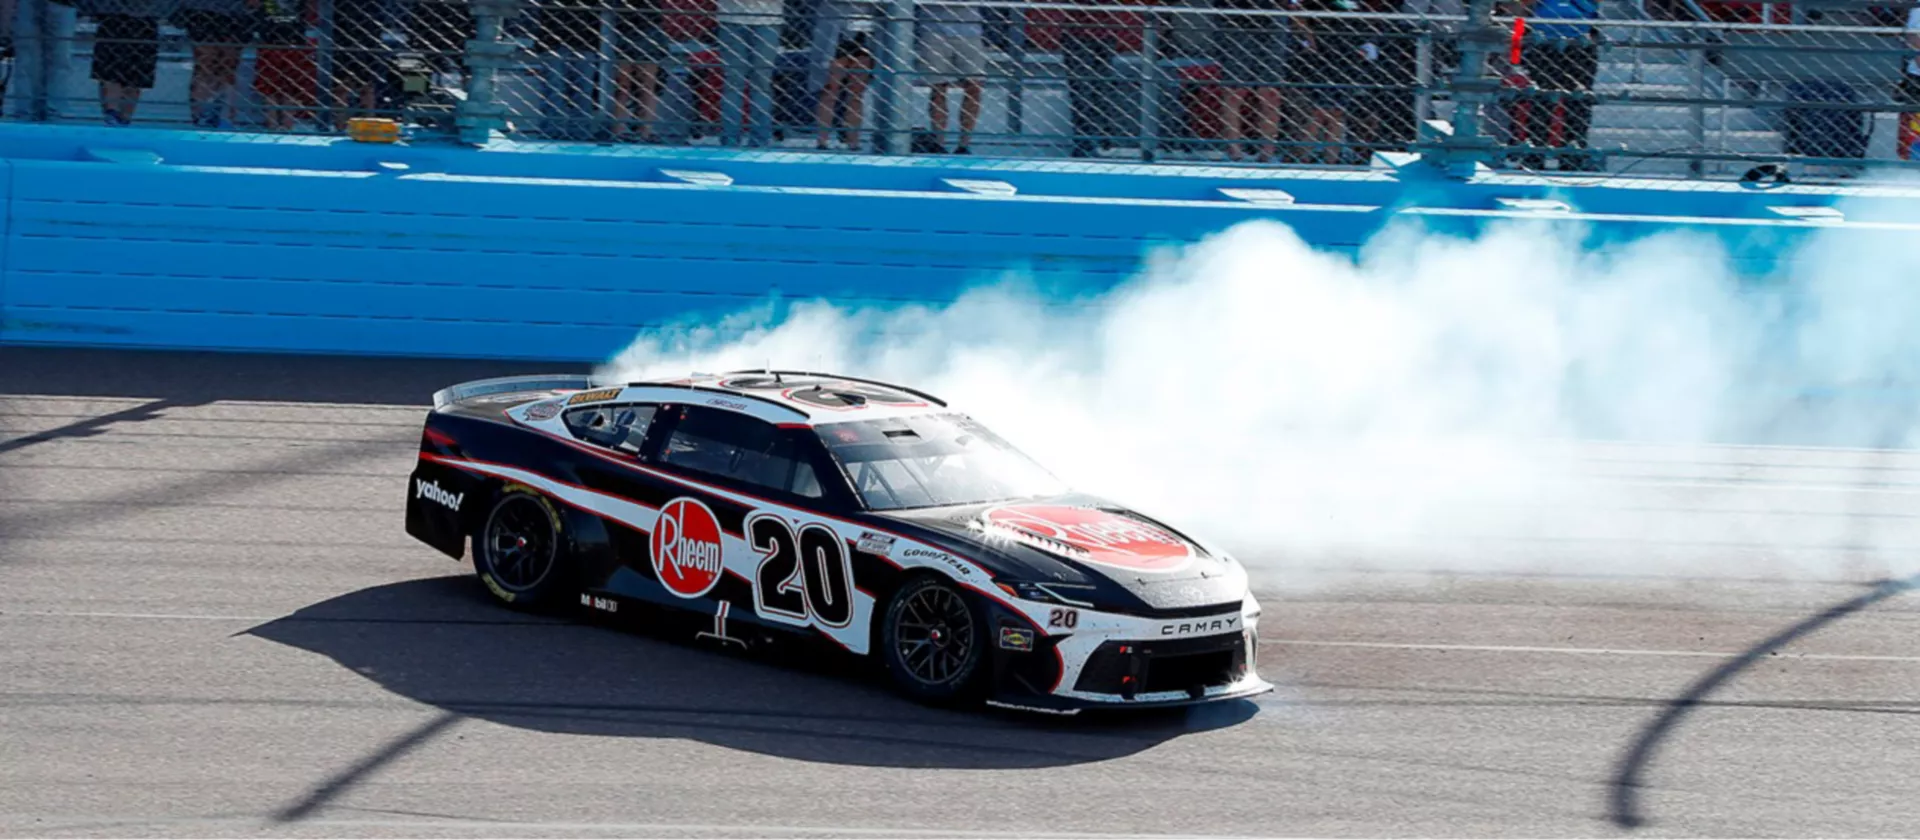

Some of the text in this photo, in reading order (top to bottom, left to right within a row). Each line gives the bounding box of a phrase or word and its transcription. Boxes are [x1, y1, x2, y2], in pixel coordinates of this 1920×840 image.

[416, 478, 464, 511] yahoo!
[658, 500, 719, 580] Rheem
[749, 512, 853, 628] 20
[903, 548, 971, 575] GOODYEAR
[1049, 608, 1079, 628] 20
